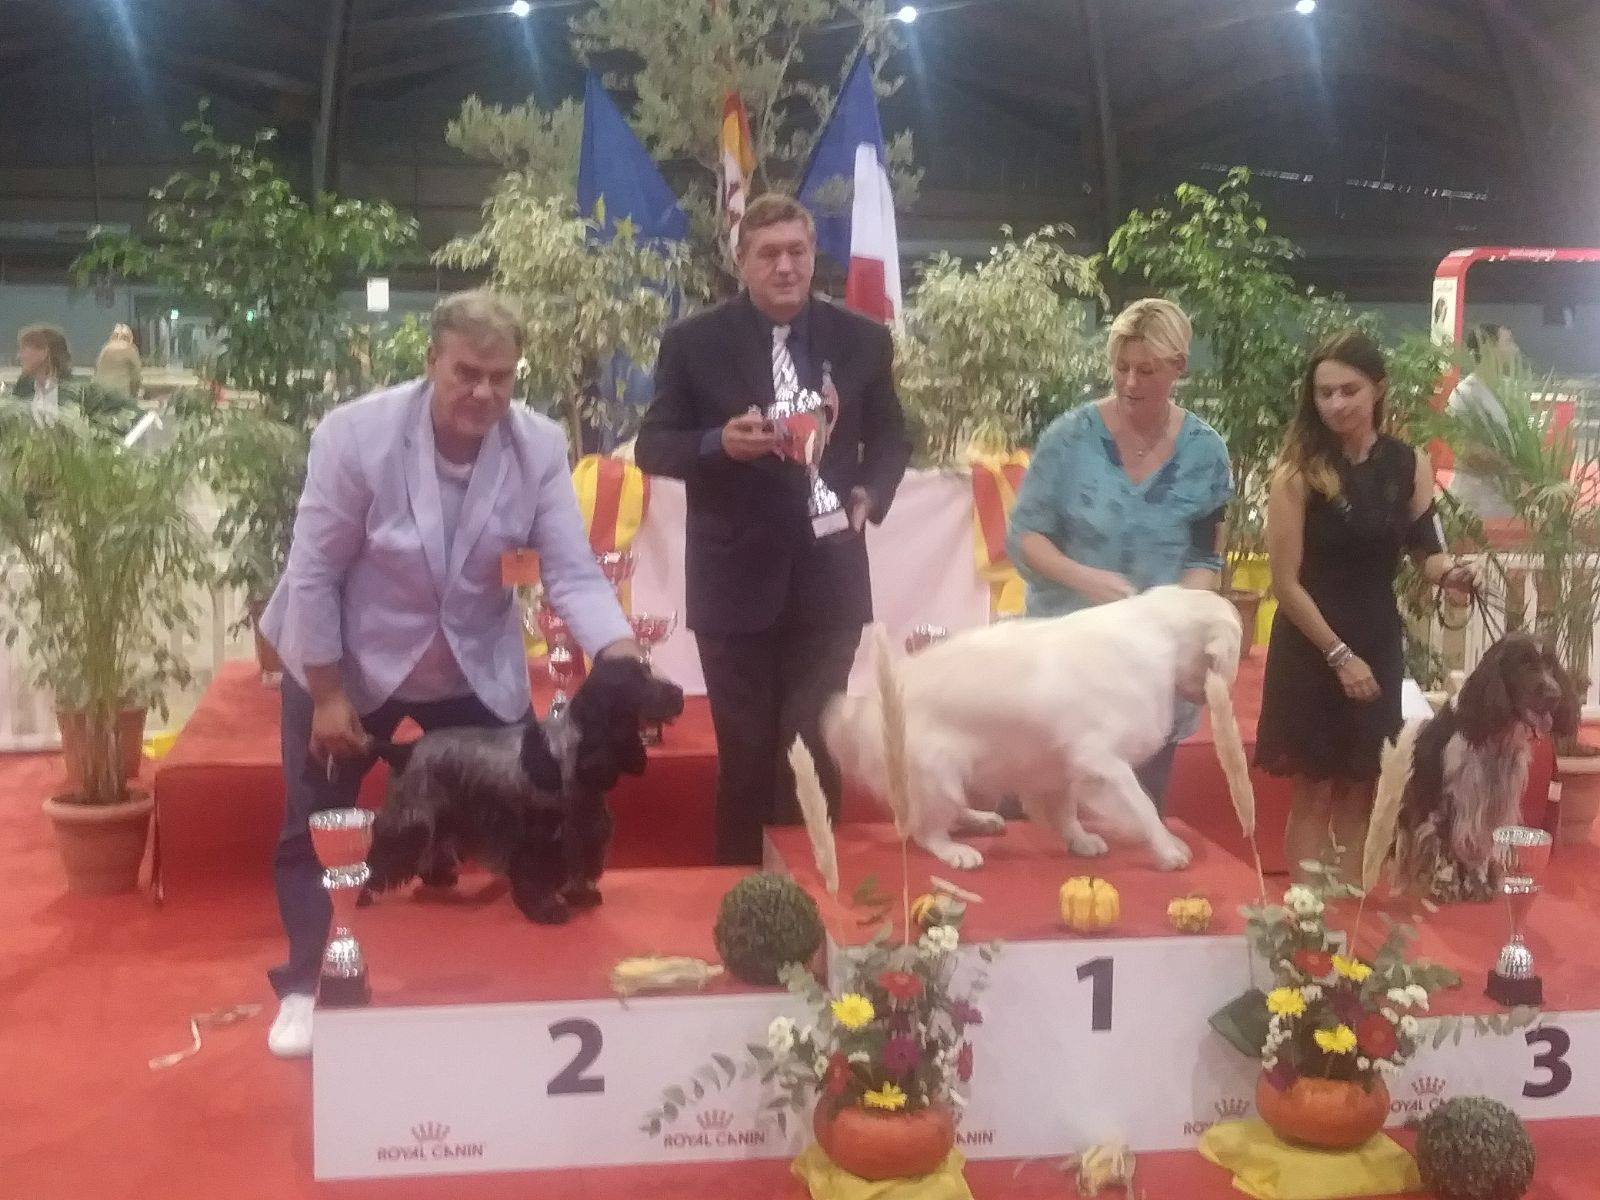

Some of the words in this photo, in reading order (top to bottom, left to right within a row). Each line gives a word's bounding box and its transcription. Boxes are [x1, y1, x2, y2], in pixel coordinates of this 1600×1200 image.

[1076, 956, 1114, 1031] 1
[547, 1017, 605, 1096] 2
[1522, 1027, 1573, 1098] 3
[1388, 1100, 1423, 1112] OYAL
[663, 1132, 711, 1147] ROYAL
[715, 1130, 765, 1145] CANIN
[953, 1130, 993, 1145] ANIN
[377, 1144, 424, 1161] ROYAL
[432, 1143, 483, 1158] CANIN
